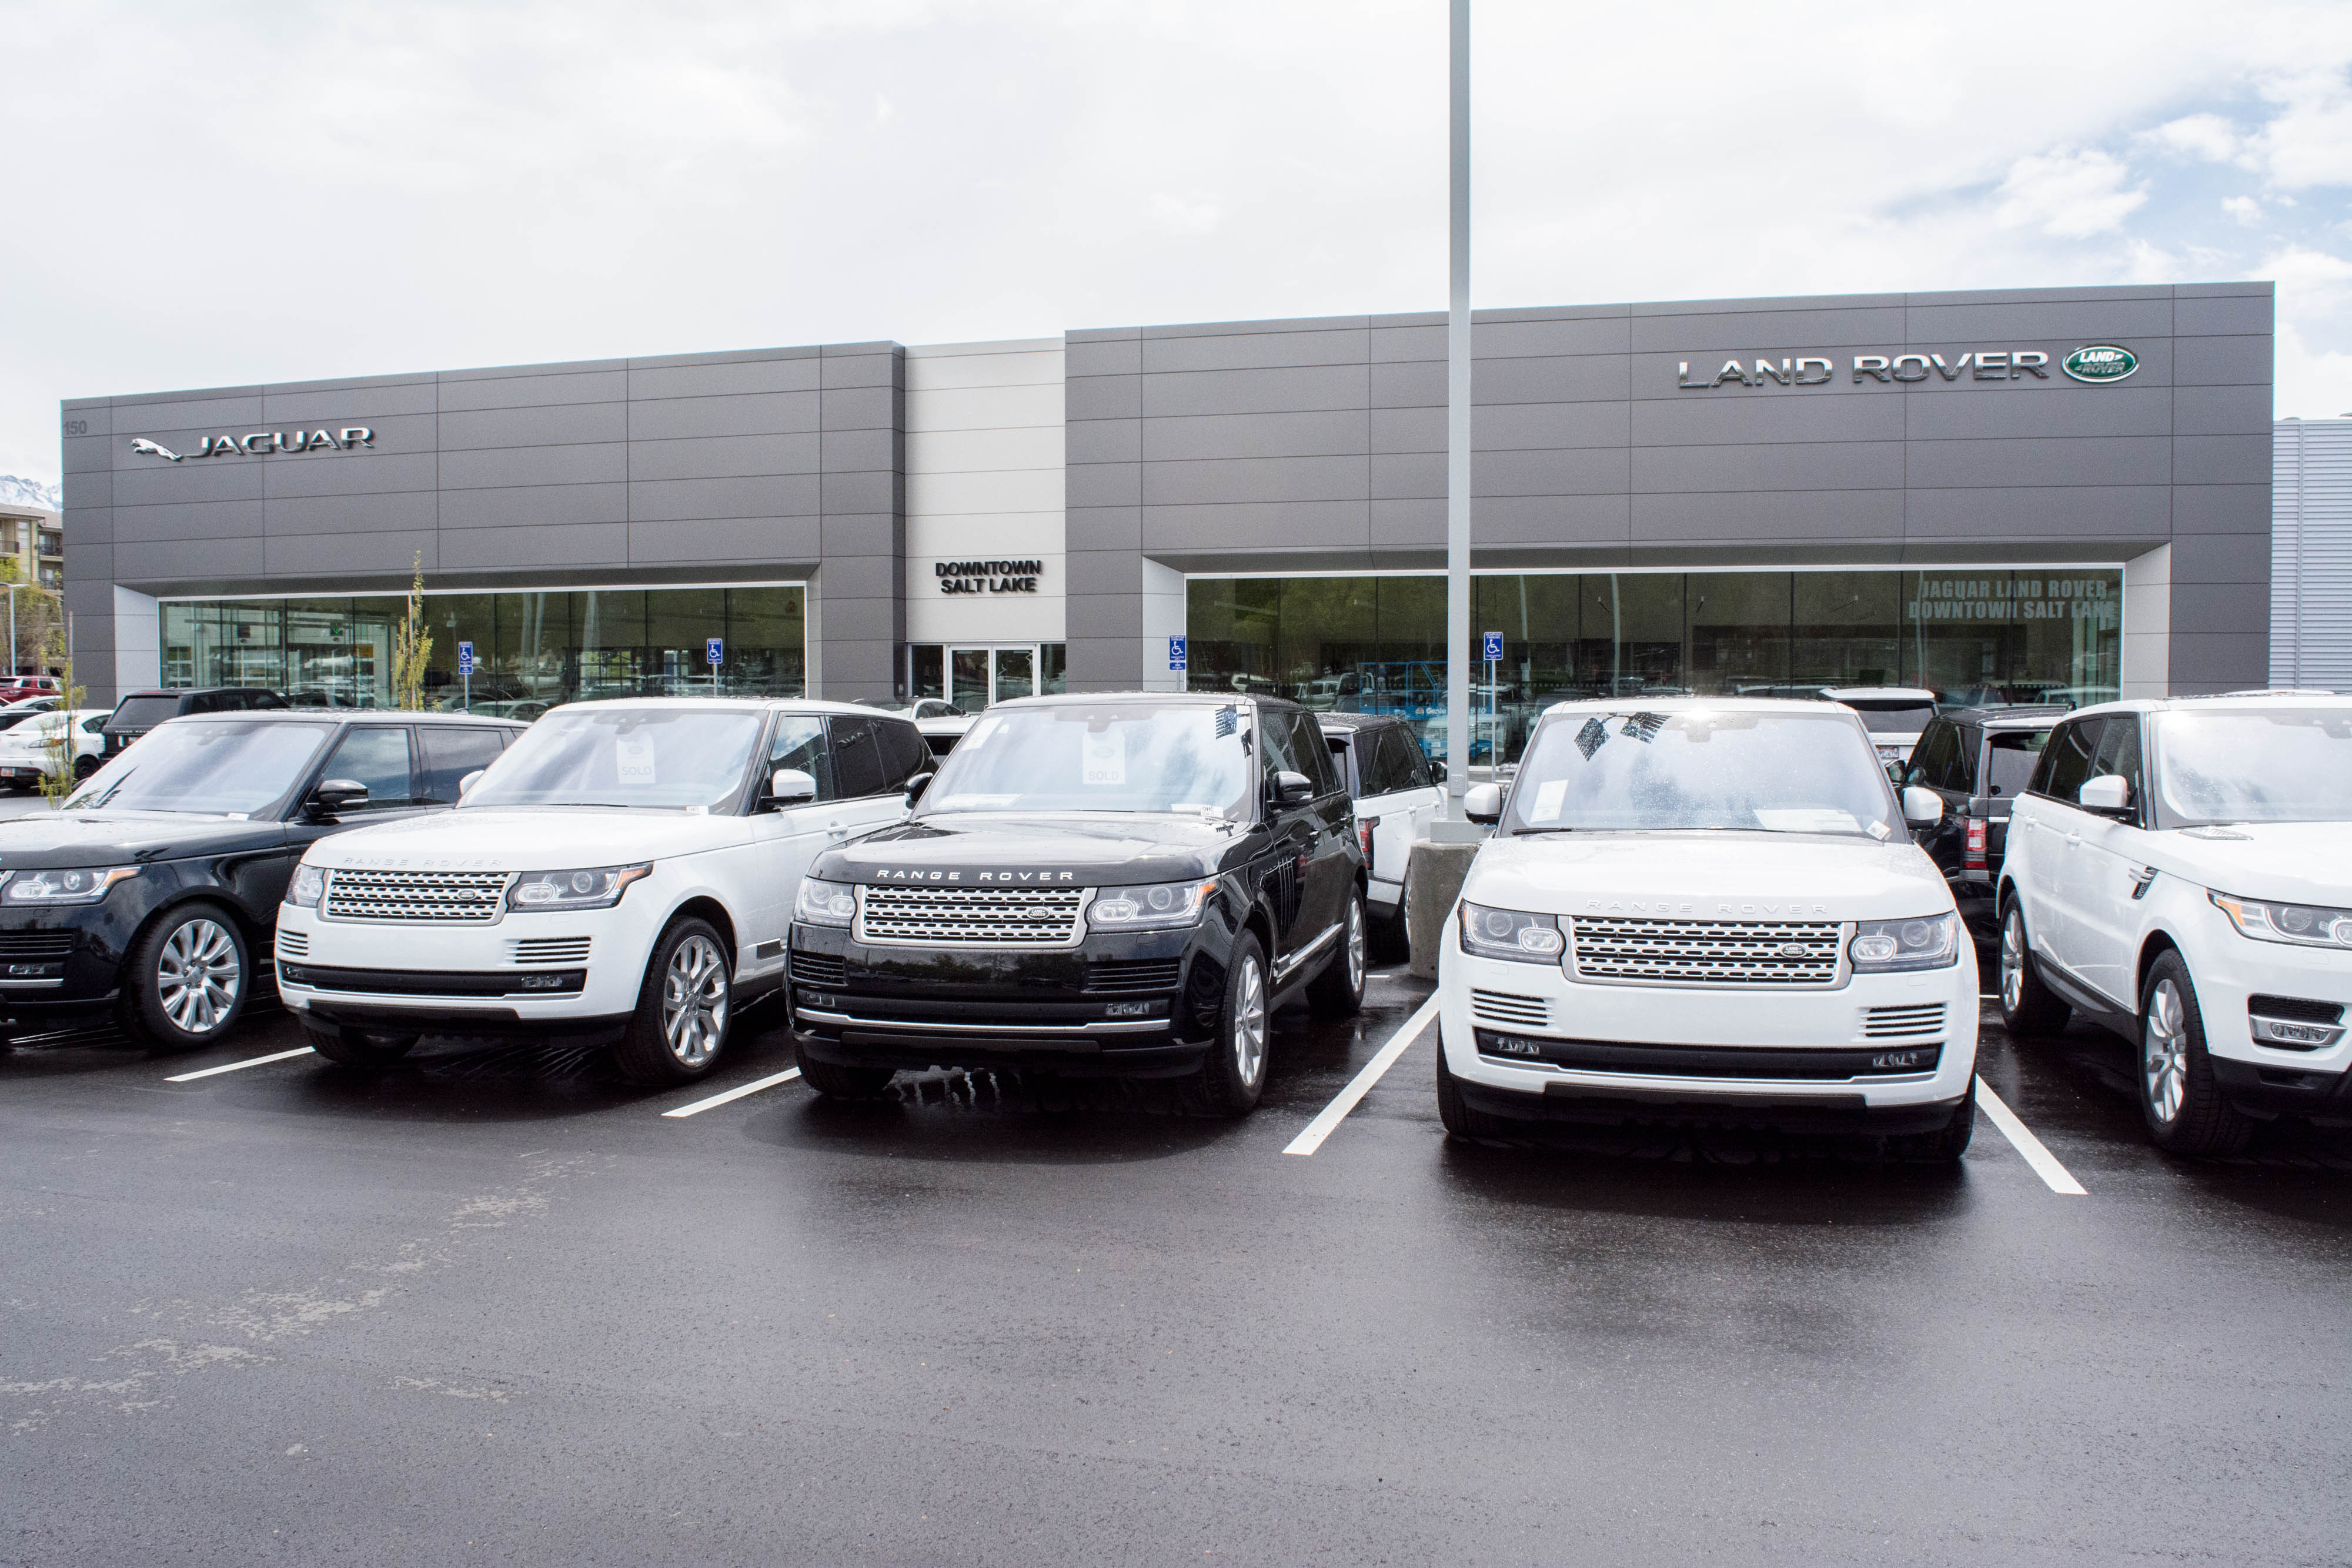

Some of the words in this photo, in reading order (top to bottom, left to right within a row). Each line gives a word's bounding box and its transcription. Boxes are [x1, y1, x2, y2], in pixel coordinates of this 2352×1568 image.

[2080, 352, 2116, 362] LAND
[1679, 357, 1833, 388] LAND
[1853, 351, 2050, 383] ROVER
[2082, 362, 2126, 373] ROVER
[64, 420, 88, 434] 150
[185, 427, 374, 457] JAGUAR
[936, 560, 1042, 577] DOWNTOWN
[941, 578, 985, 594] SALT
[989, 577, 1037, 593] LAKE
[1922, 580, 1990, 599] JAGUAR
[1996, 580, 2043, 598] LAND
[2048, 580, 2108, 599] ROVER
[2023, 601, 2066, 618] SALT
[621, 766, 652, 775] SOLD
[1088, 771, 1119, 781] SOLD
[343, 857, 409, 866] RANGE
[877, 870, 961, 880] RANGE
[979, 872, 1073, 881] ROVER
[1586, 899, 1693, 912] RANGE
[1717, 904, 1828, 914] ROVER
